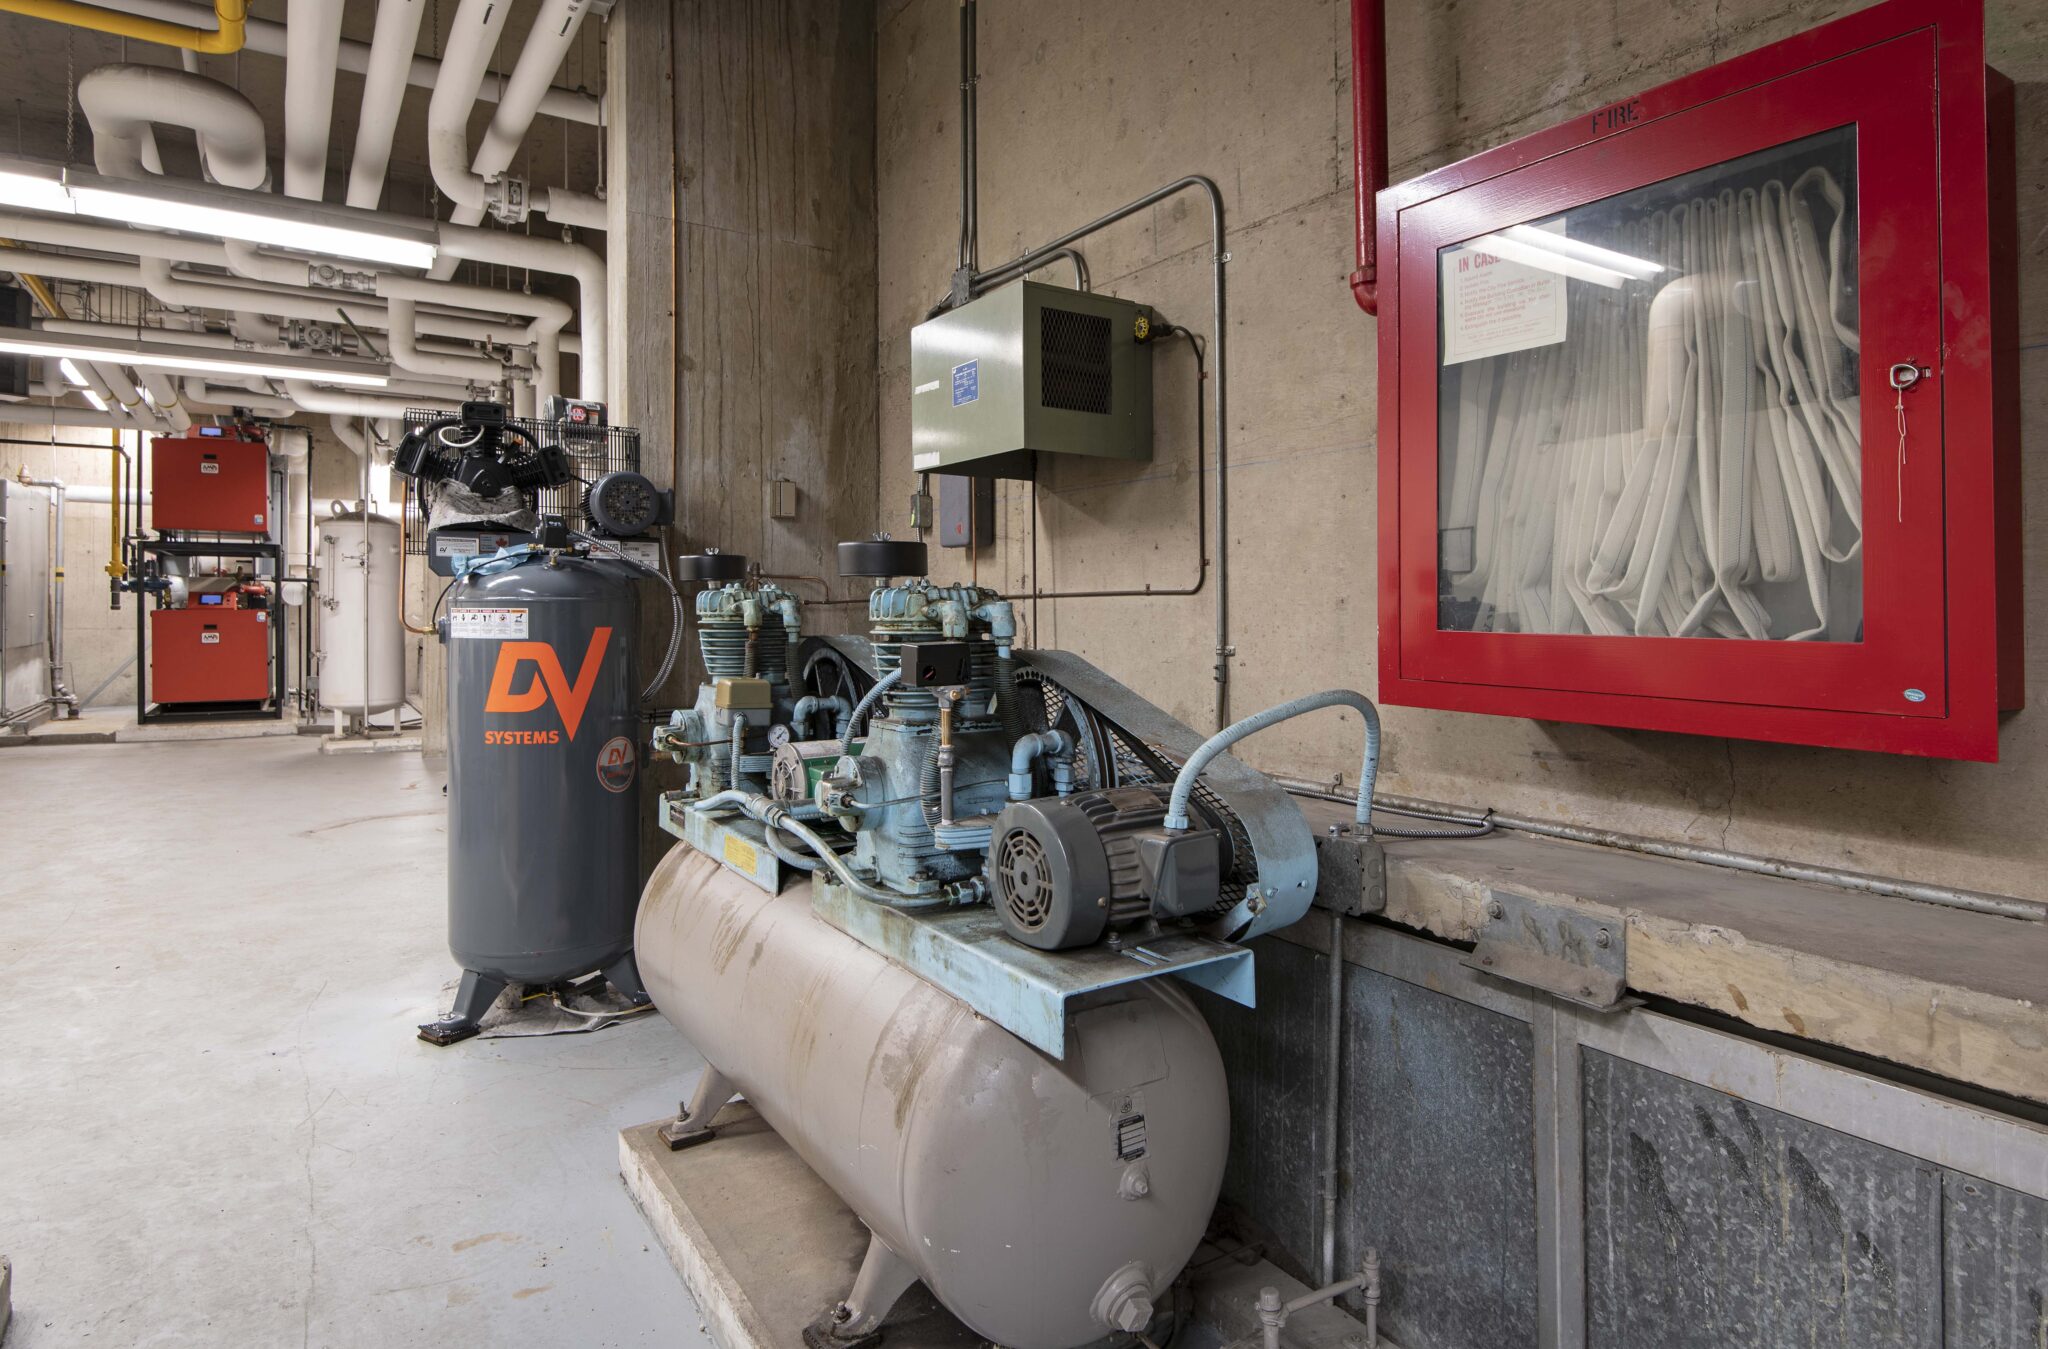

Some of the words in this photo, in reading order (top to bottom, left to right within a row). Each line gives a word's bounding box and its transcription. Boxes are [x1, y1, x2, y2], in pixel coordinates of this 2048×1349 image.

[1592, 100, 1640, 134] FIRE
[1459, 256, 1469, 273] IN
[484, 626, 613, 743] DV
[484, 730, 560, 745] SYSTEMS
